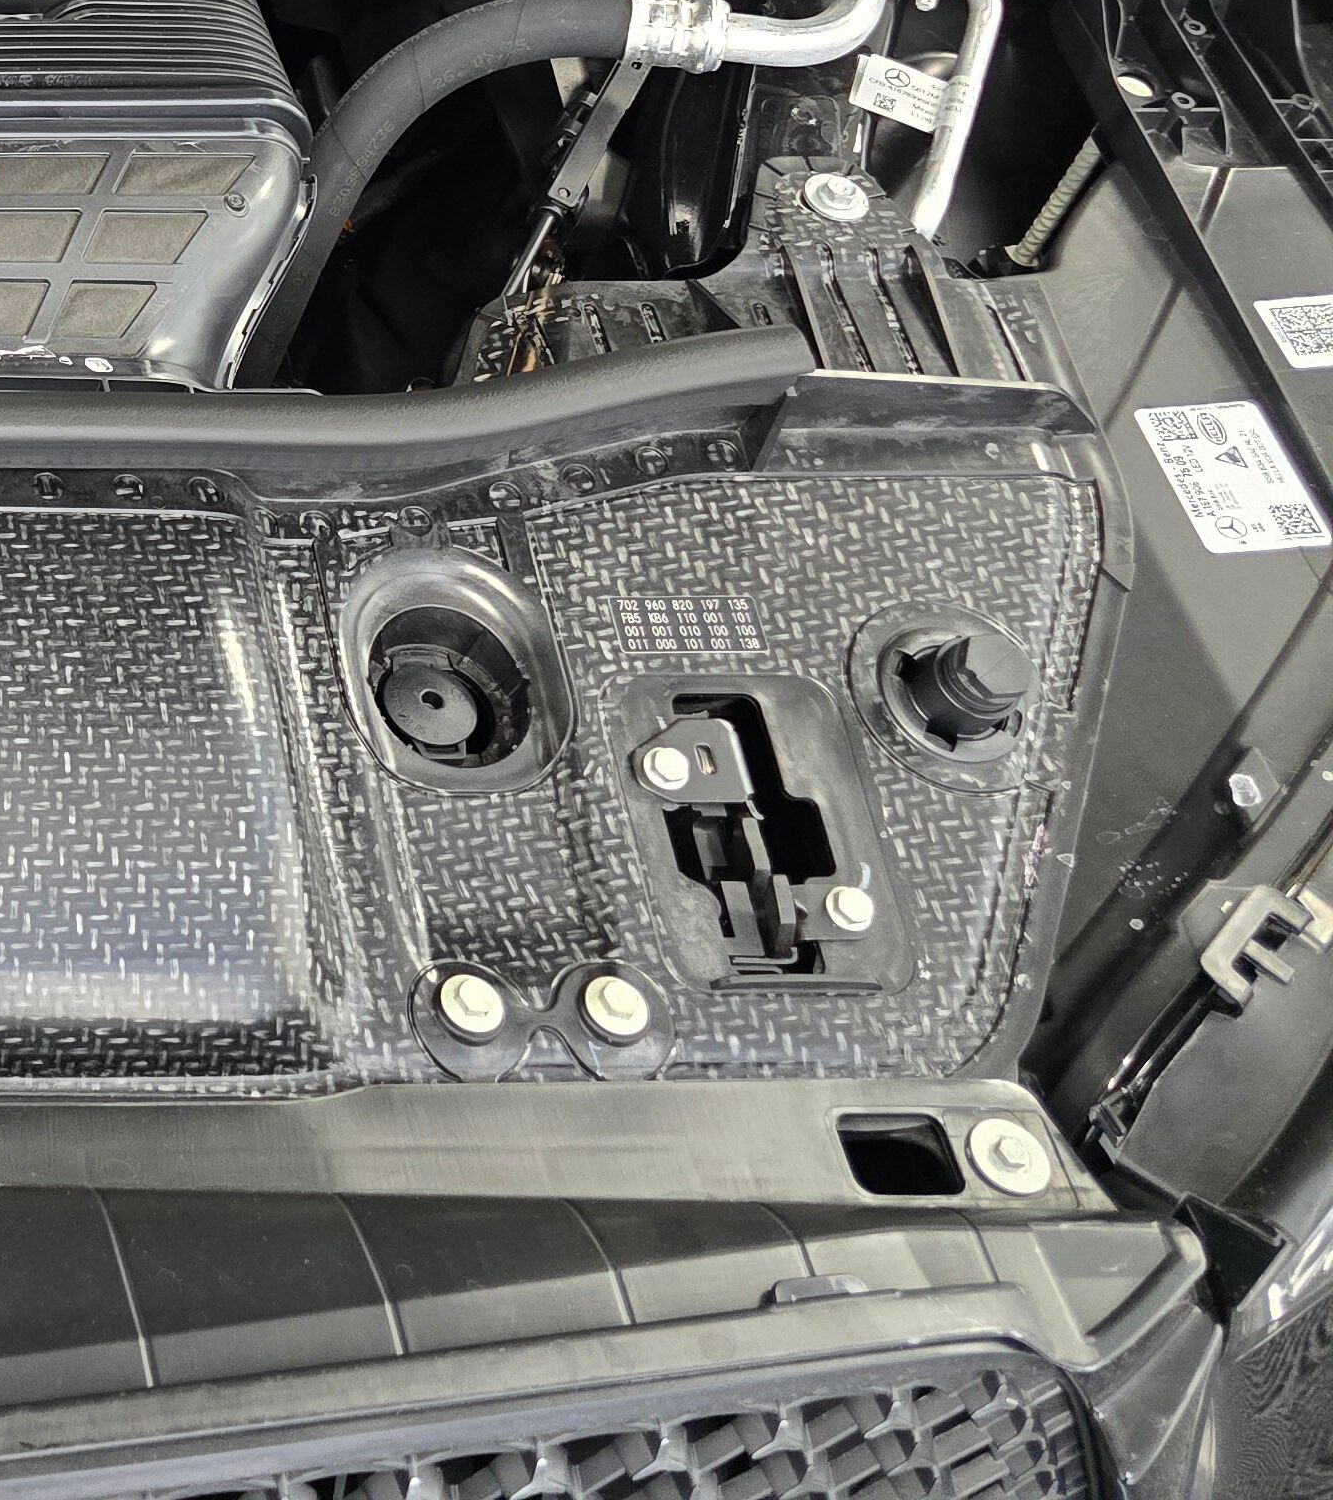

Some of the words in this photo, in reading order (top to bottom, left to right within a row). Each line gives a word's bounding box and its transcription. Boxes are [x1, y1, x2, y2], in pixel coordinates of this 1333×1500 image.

[1157, 442, 1174, 463] Benz
[1175, 473, 1203, 518] Mercedes
[617, 599, 639, 611] 702
[644, 599, 666, 611] 960
[671, 599, 694, 611] 820
[700, 599, 719, 611] 197
[727, 599, 749, 611] 135
[620, 612, 642, 624] FB5
[648, 612, 669, 624] KB6
[676, 612, 698, 624] 110
[702, 612, 724, 624] 001
[731, 612, 751, 624] 101
[624, 625, 645, 637] 001
[651, 625, 673, 637] 001
[679, 625, 701, 637] 010
[707, 625, 728, 637] 100
[735, 625, 757, 637] 100
[628, 638, 649, 650] 011
[655, 638, 677, 650] 000
[683, 638, 704, 650] 101
[710, 638, 732, 650] 001
[739, 638, 760, 650] 138
